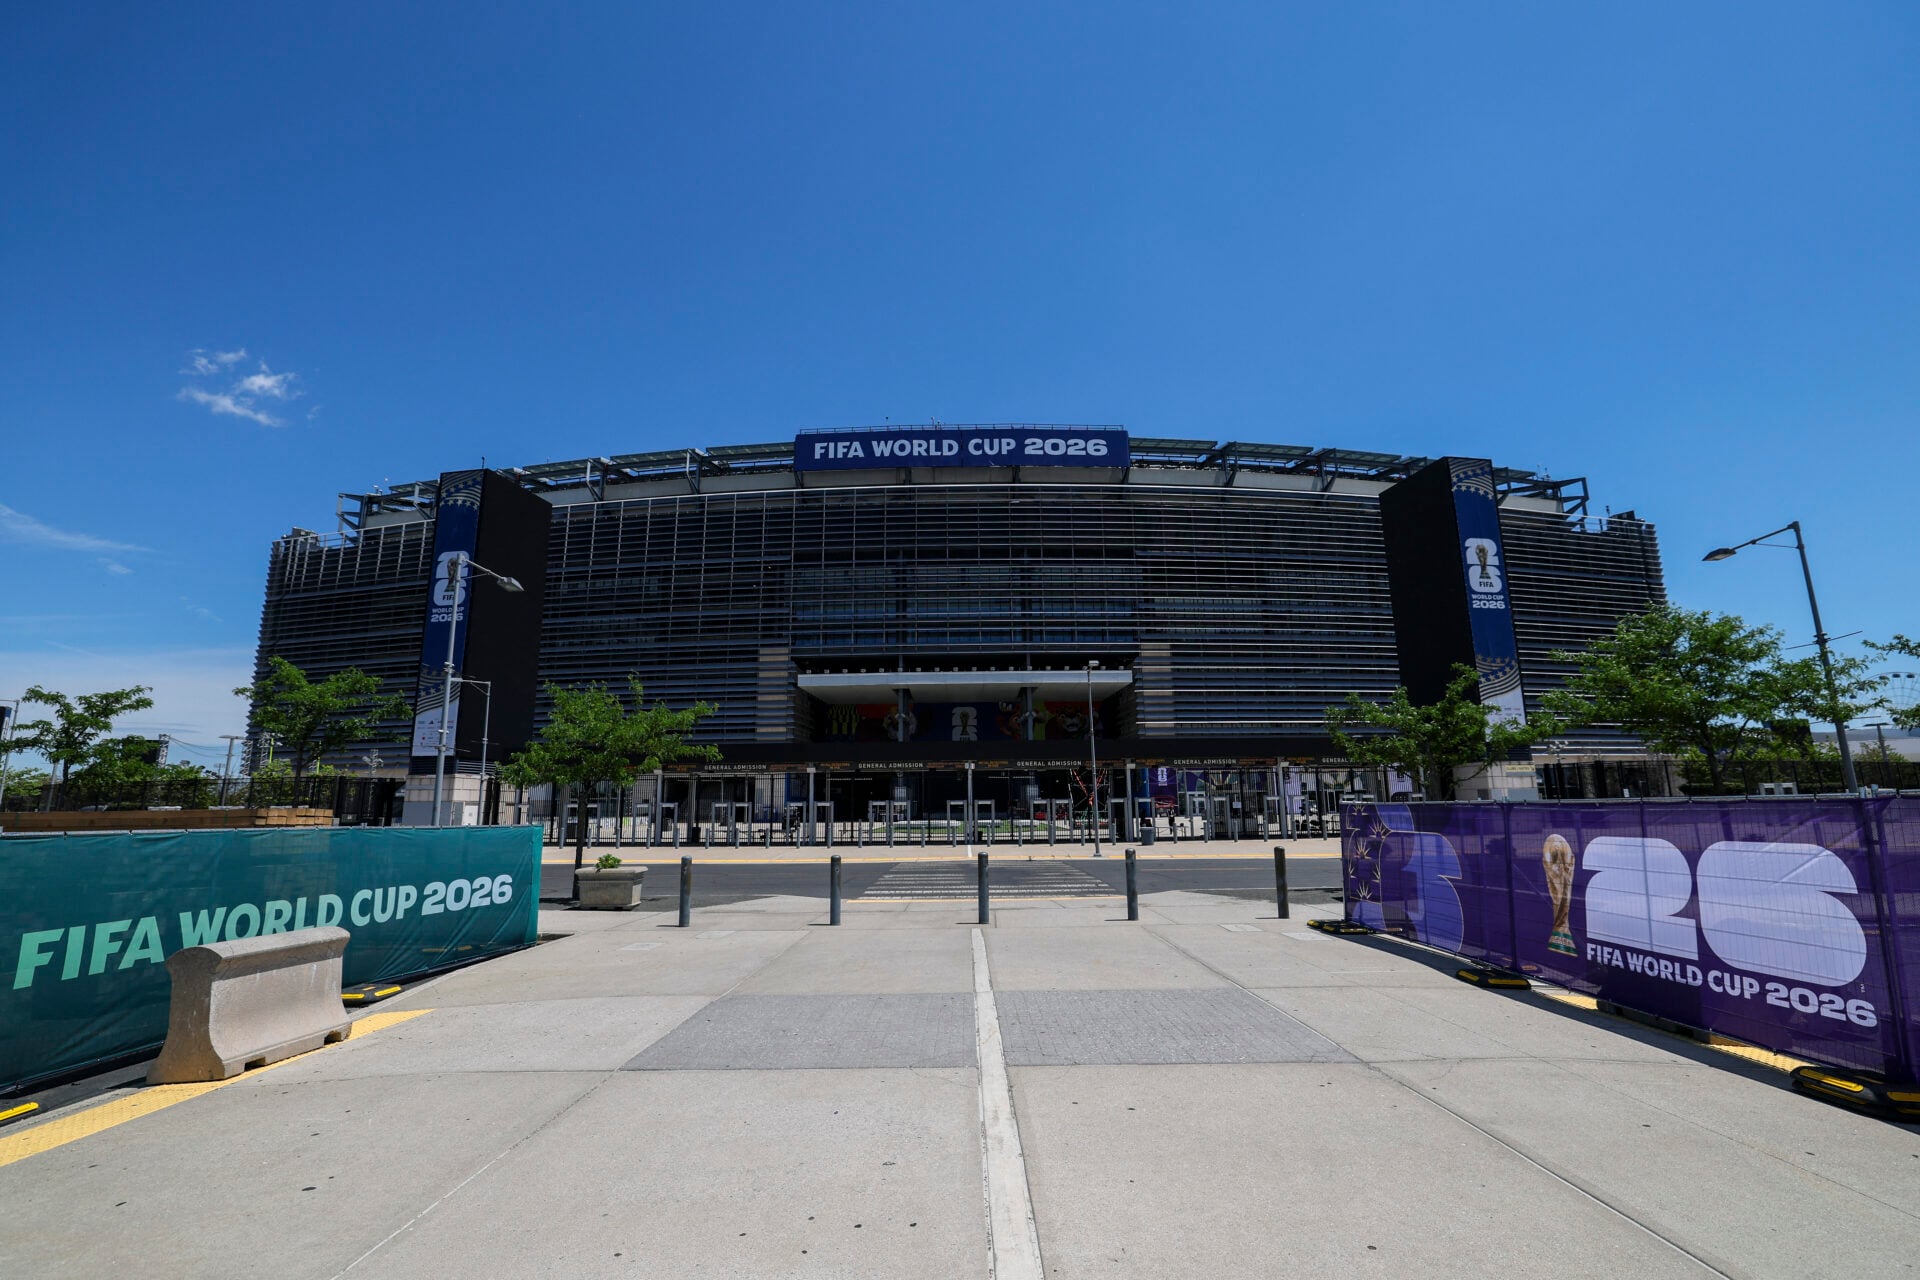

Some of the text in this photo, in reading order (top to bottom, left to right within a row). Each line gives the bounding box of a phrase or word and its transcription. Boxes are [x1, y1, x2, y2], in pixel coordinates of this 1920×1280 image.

[814, 438, 1108, 459] FIFA WORLD CUP 2026
[1472, 600, 1505, 609] 2026
[13, 874, 513, 990] FIFA WORLD CUP 2026
[1586, 942, 1878, 1029] FIFA WORLD CUP 2026
